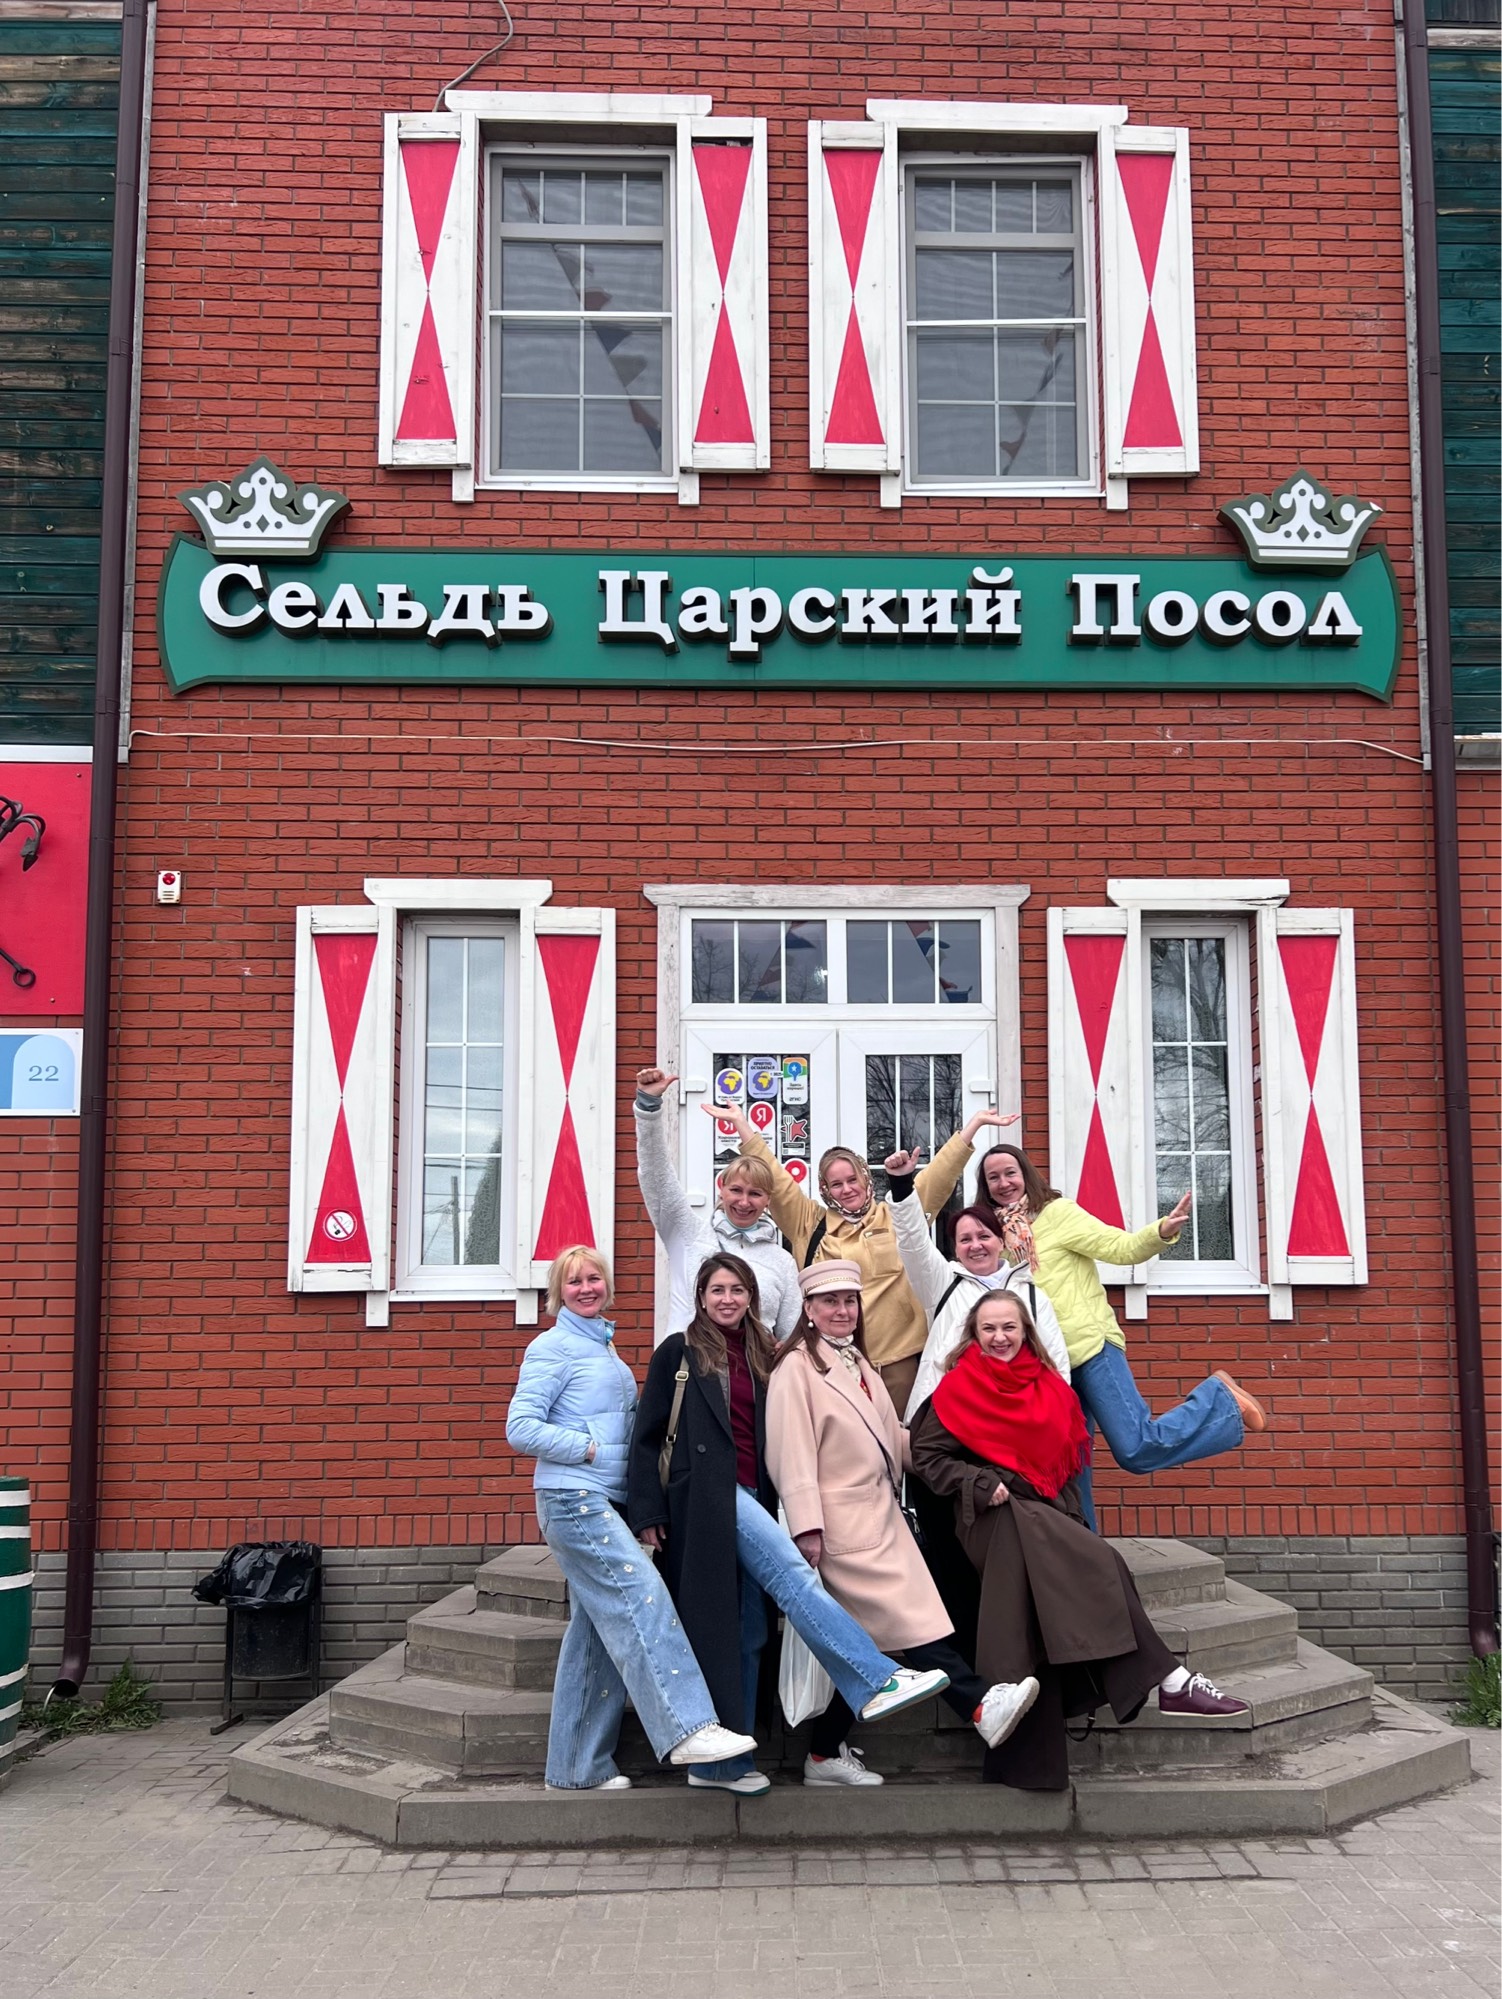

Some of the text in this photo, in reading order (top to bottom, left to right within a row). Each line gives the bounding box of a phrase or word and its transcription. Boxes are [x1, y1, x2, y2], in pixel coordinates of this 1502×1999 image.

[199, 563, 1364, 654] Сельдь Царский Посол
[28, 1065, 59, 1082] 22
[756, 1107, 767, 1122] Я
